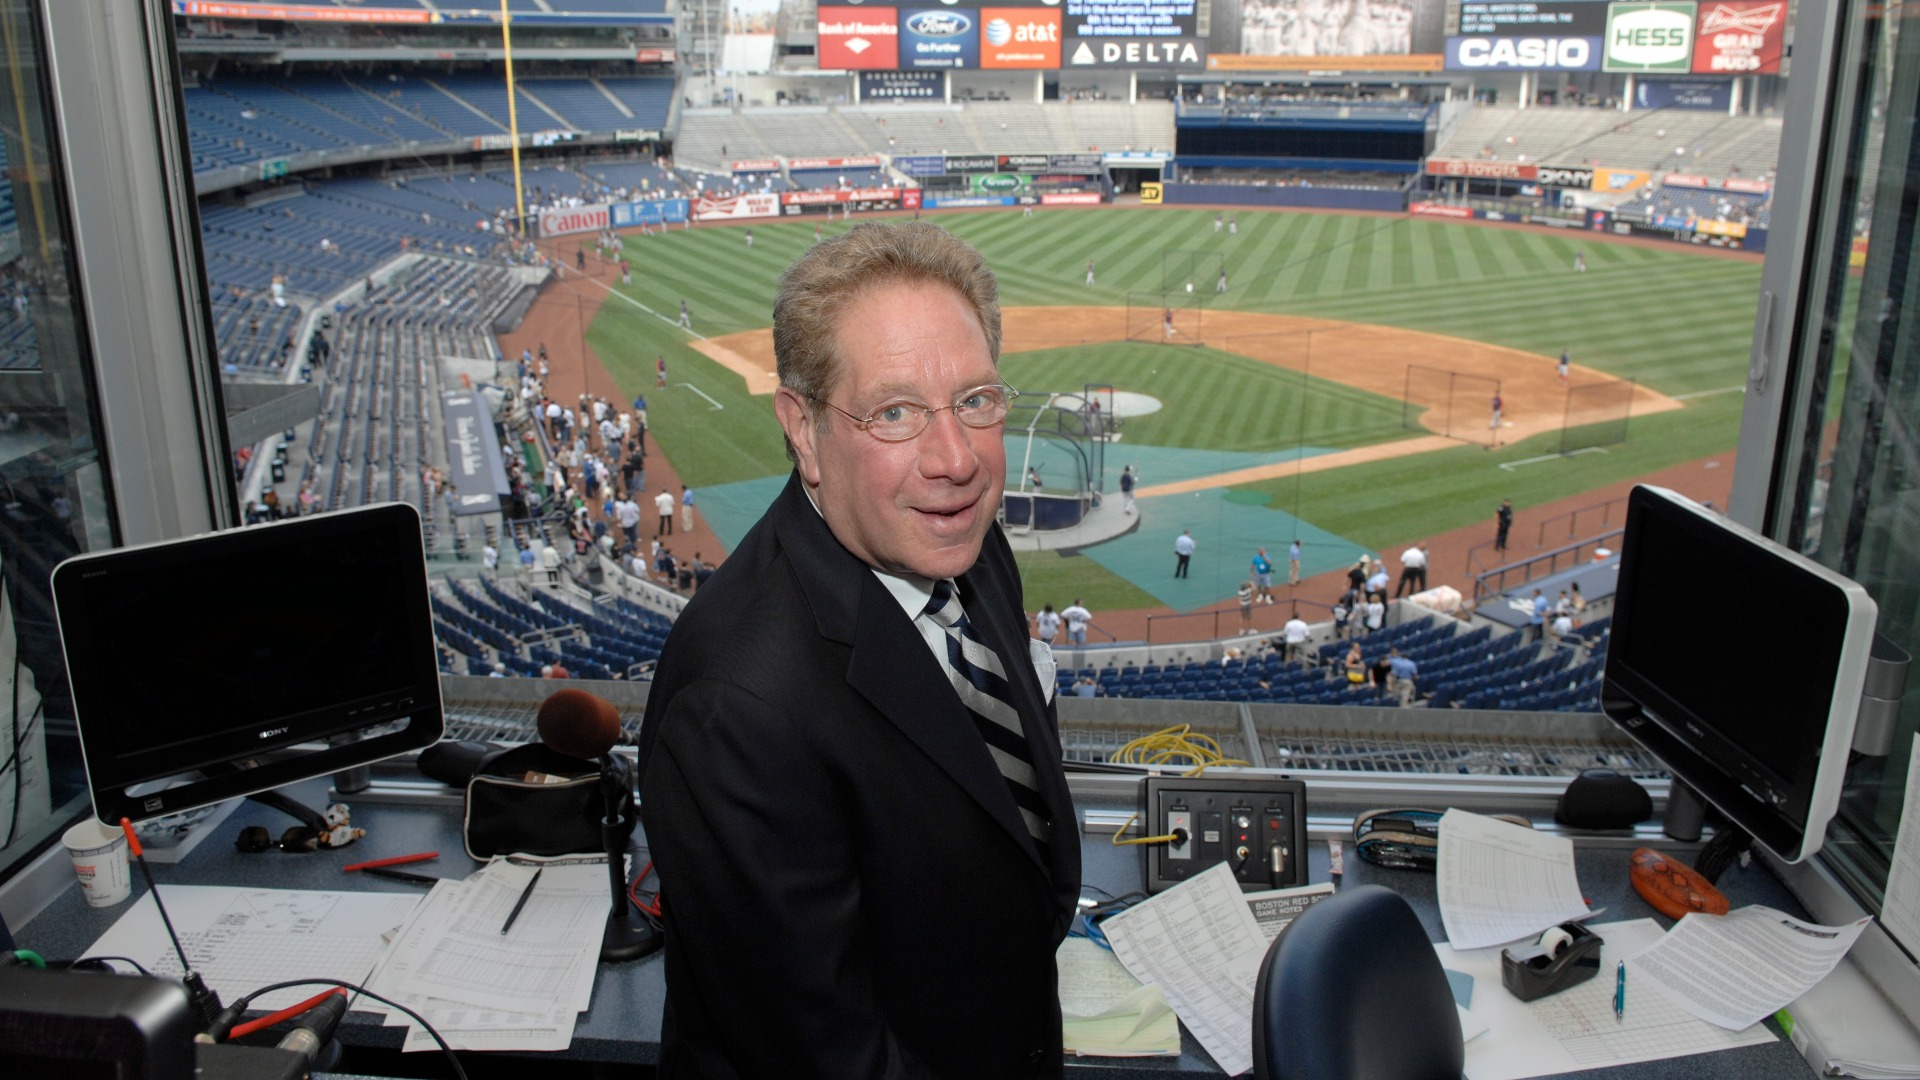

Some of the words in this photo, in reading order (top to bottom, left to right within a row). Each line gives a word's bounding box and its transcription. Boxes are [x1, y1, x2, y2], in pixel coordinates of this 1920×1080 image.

[818, 22, 843, 34] Bank
[844, 22, 855, 34] of
[856, 22, 898, 34] America
[918, 14, 959, 33] Ford
[1015, 22, 1057, 43] at&t
[1616, 28, 1684, 46] HESS
[1713, 34, 1764, 49] GRAB
[1103, 43, 1198, 63] DELTA
[1459, 38, 1589, 67] CASIO
[1711, 55, 1761, 70] BUDS
[1467, 164, 1520, 177] TOYOTA
[1537, 169, 1593, 186] DKNY
[543, 209, 608, 234] Canon
[259, 726, 289, 739] SONY
[1255, 899, 1290, 911] BOSTON
[1292, 896, 1309, 906] RED
[1256, 908, 1278, 917] GAME
[1279, 905, 1303, 914] NOTES
